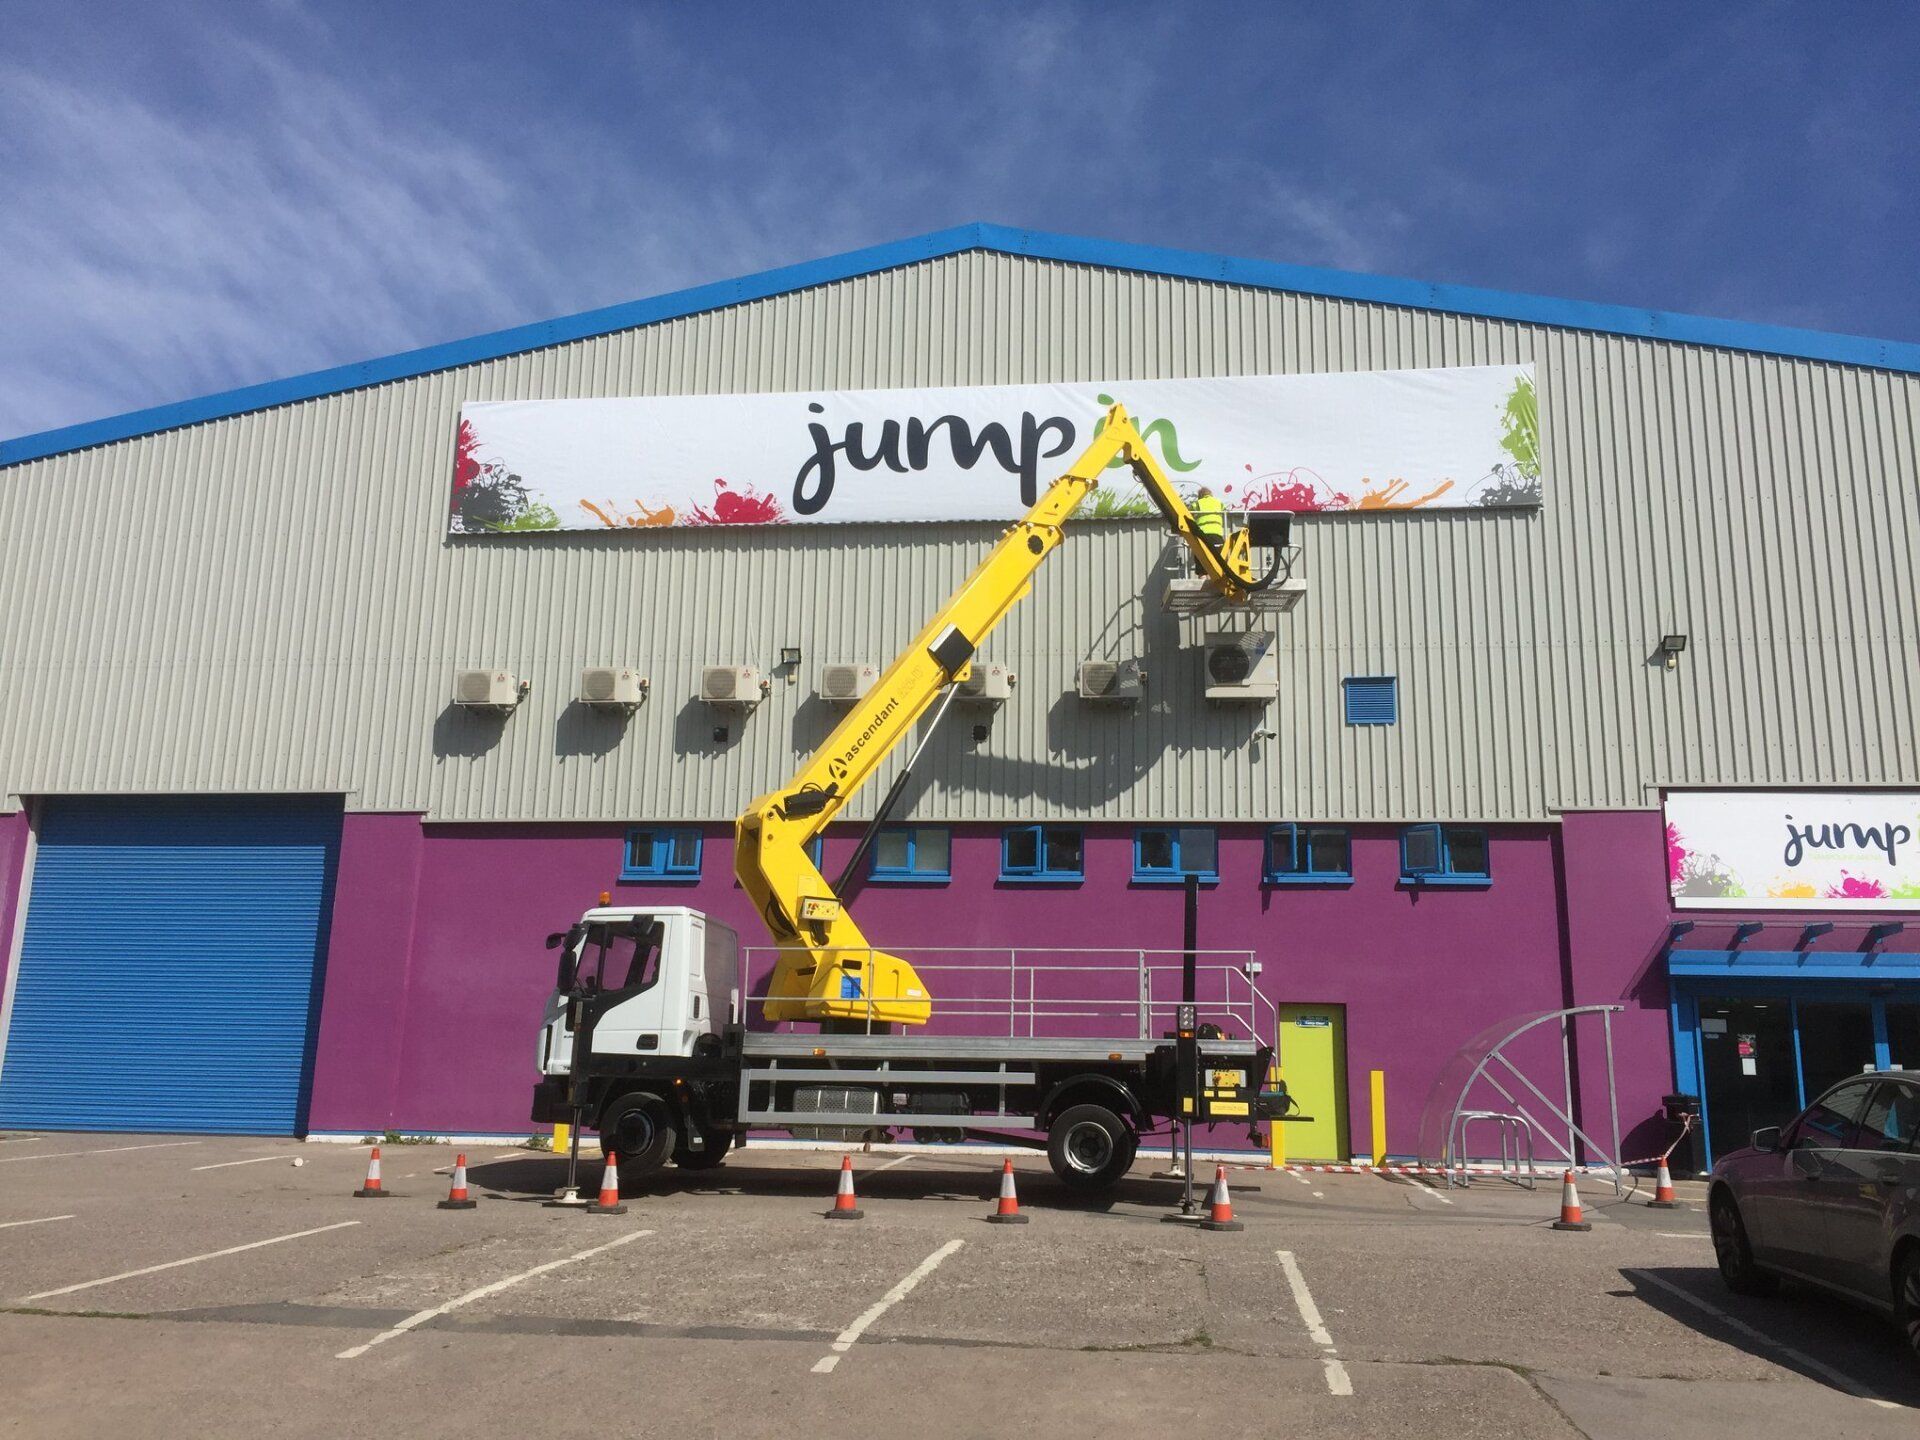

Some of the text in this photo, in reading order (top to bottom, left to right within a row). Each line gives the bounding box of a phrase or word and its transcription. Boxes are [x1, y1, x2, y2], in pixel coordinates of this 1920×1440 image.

[793, 402, 1076, 515] jump
[845, 697, 899, 761] ascendant
[1784, 814, 1911, 867] jump
